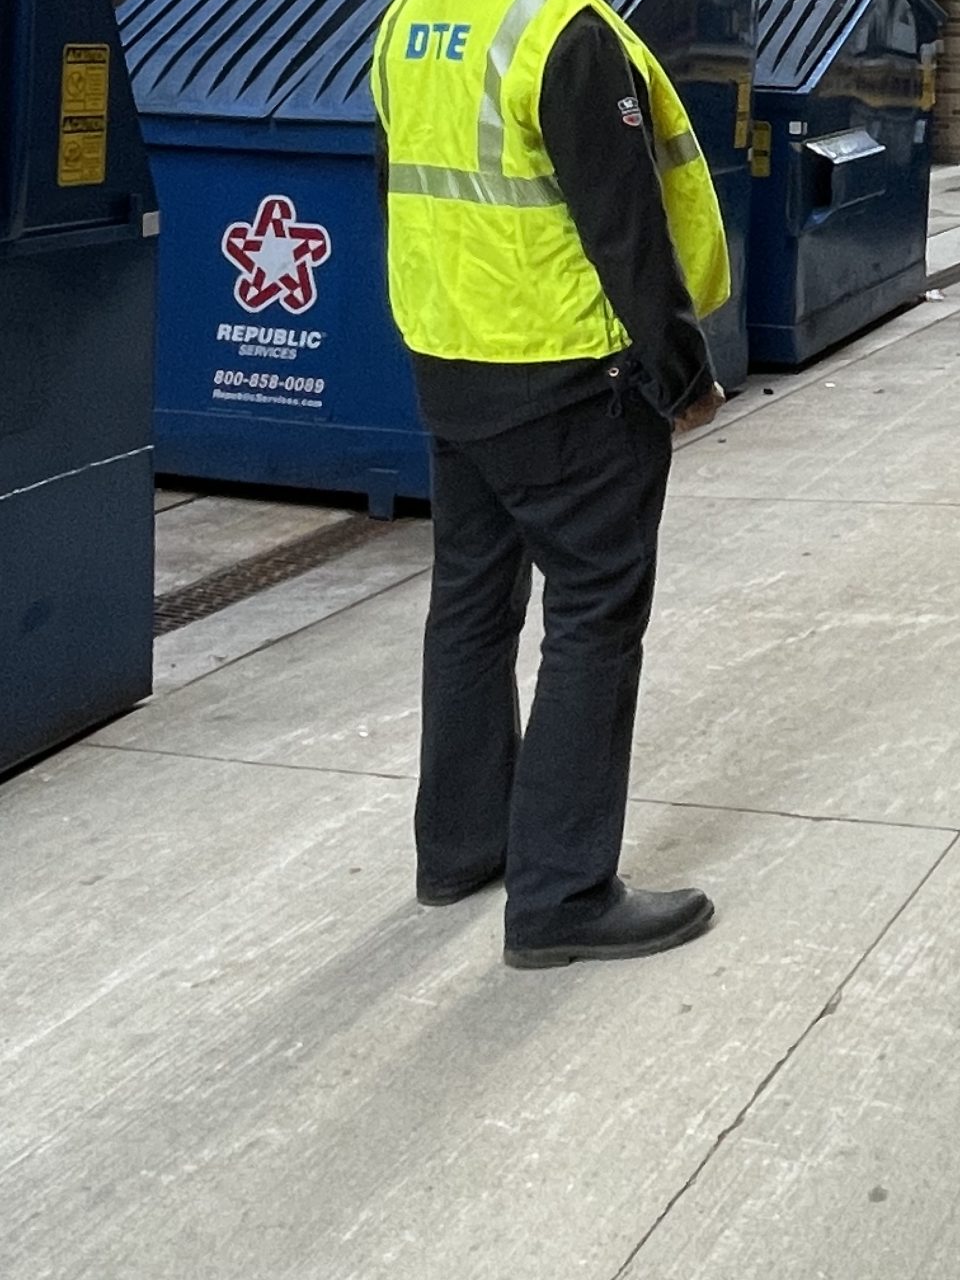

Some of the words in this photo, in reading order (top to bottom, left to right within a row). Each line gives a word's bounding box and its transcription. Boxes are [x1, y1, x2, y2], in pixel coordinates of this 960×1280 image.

[405, 23, 471, 60] DTE
[216, 323, 322, 349] REPUBLIC
[238, 344, 297, 360] SERVICES
[213, 369, 325, 394] 800-858-0089
